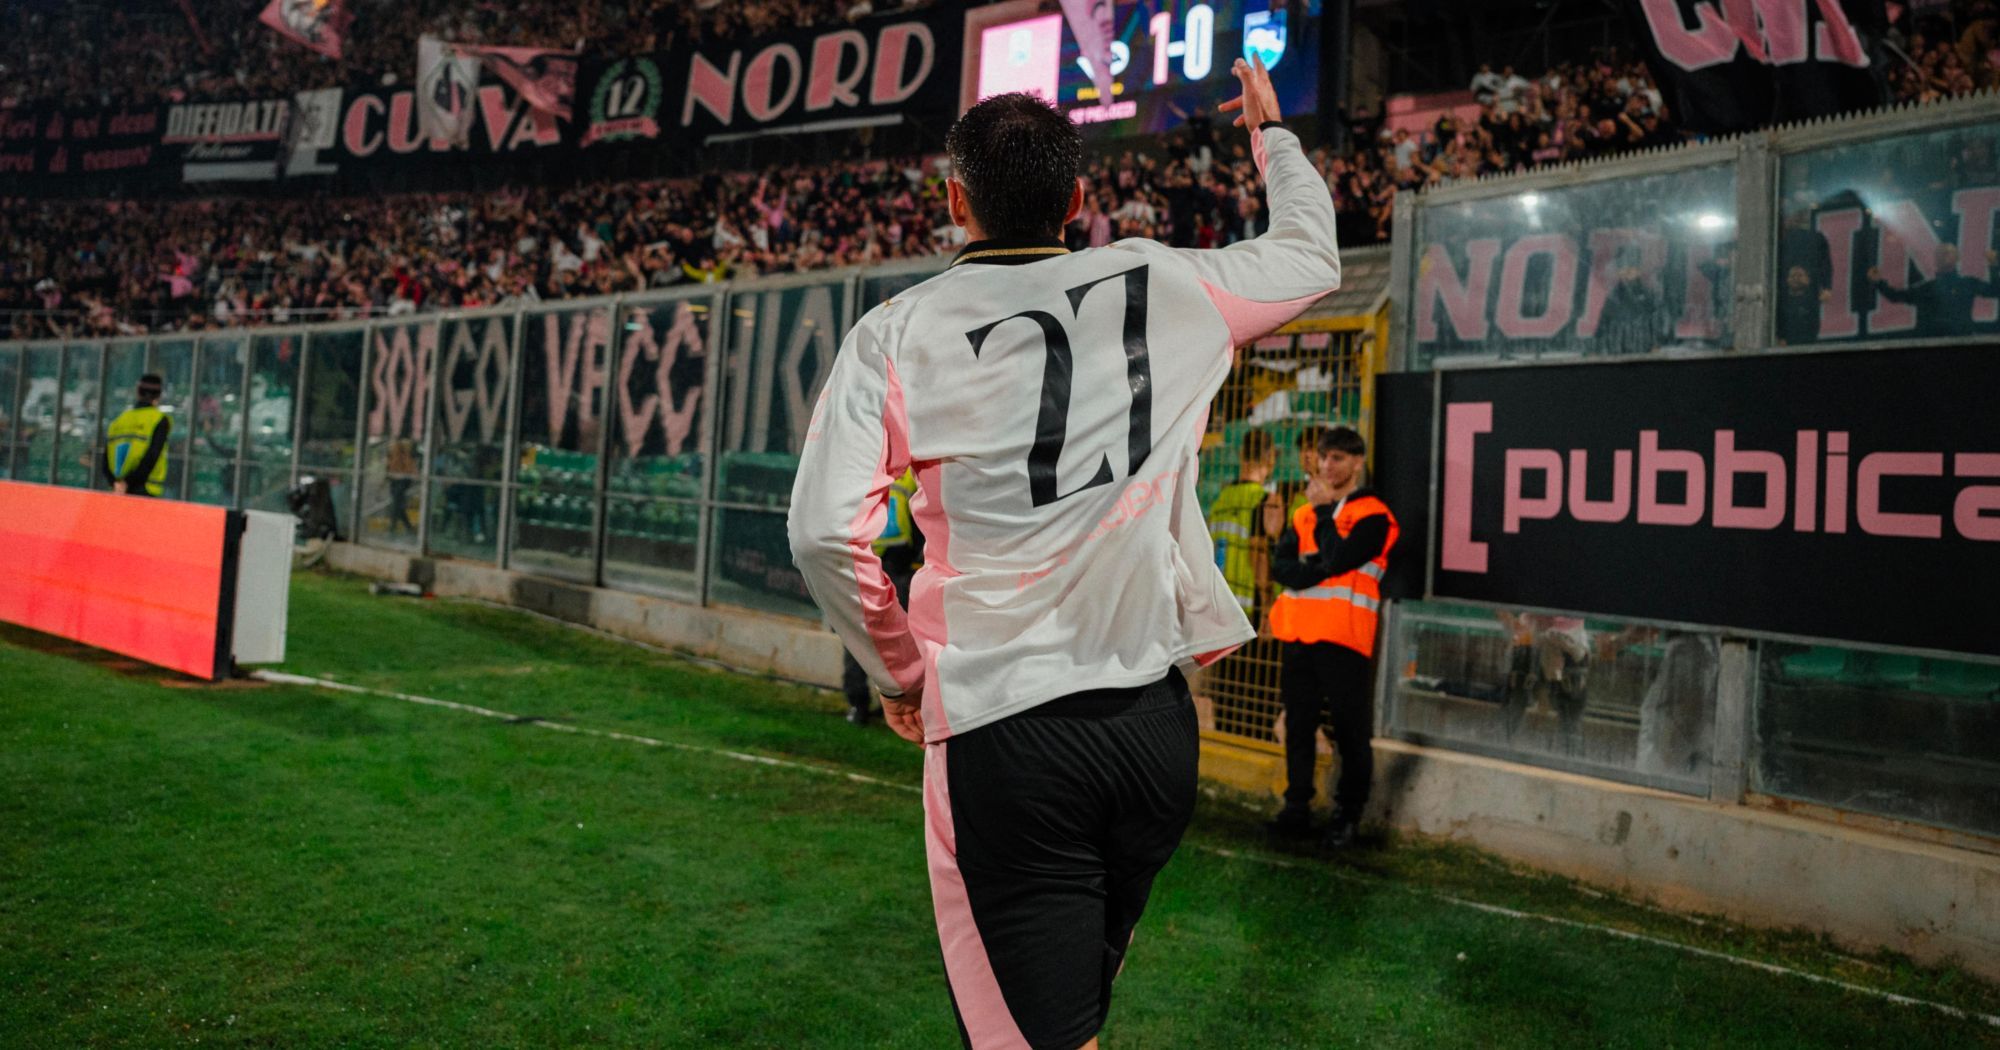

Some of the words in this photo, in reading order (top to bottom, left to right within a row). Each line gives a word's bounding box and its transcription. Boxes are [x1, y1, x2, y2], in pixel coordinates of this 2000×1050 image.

[606, 74, 645, 118] 12
[680, 21, 936, 127] NORD
[343, 84, 561, 157] CUVA
[966, 264, 1152, 509] 27
